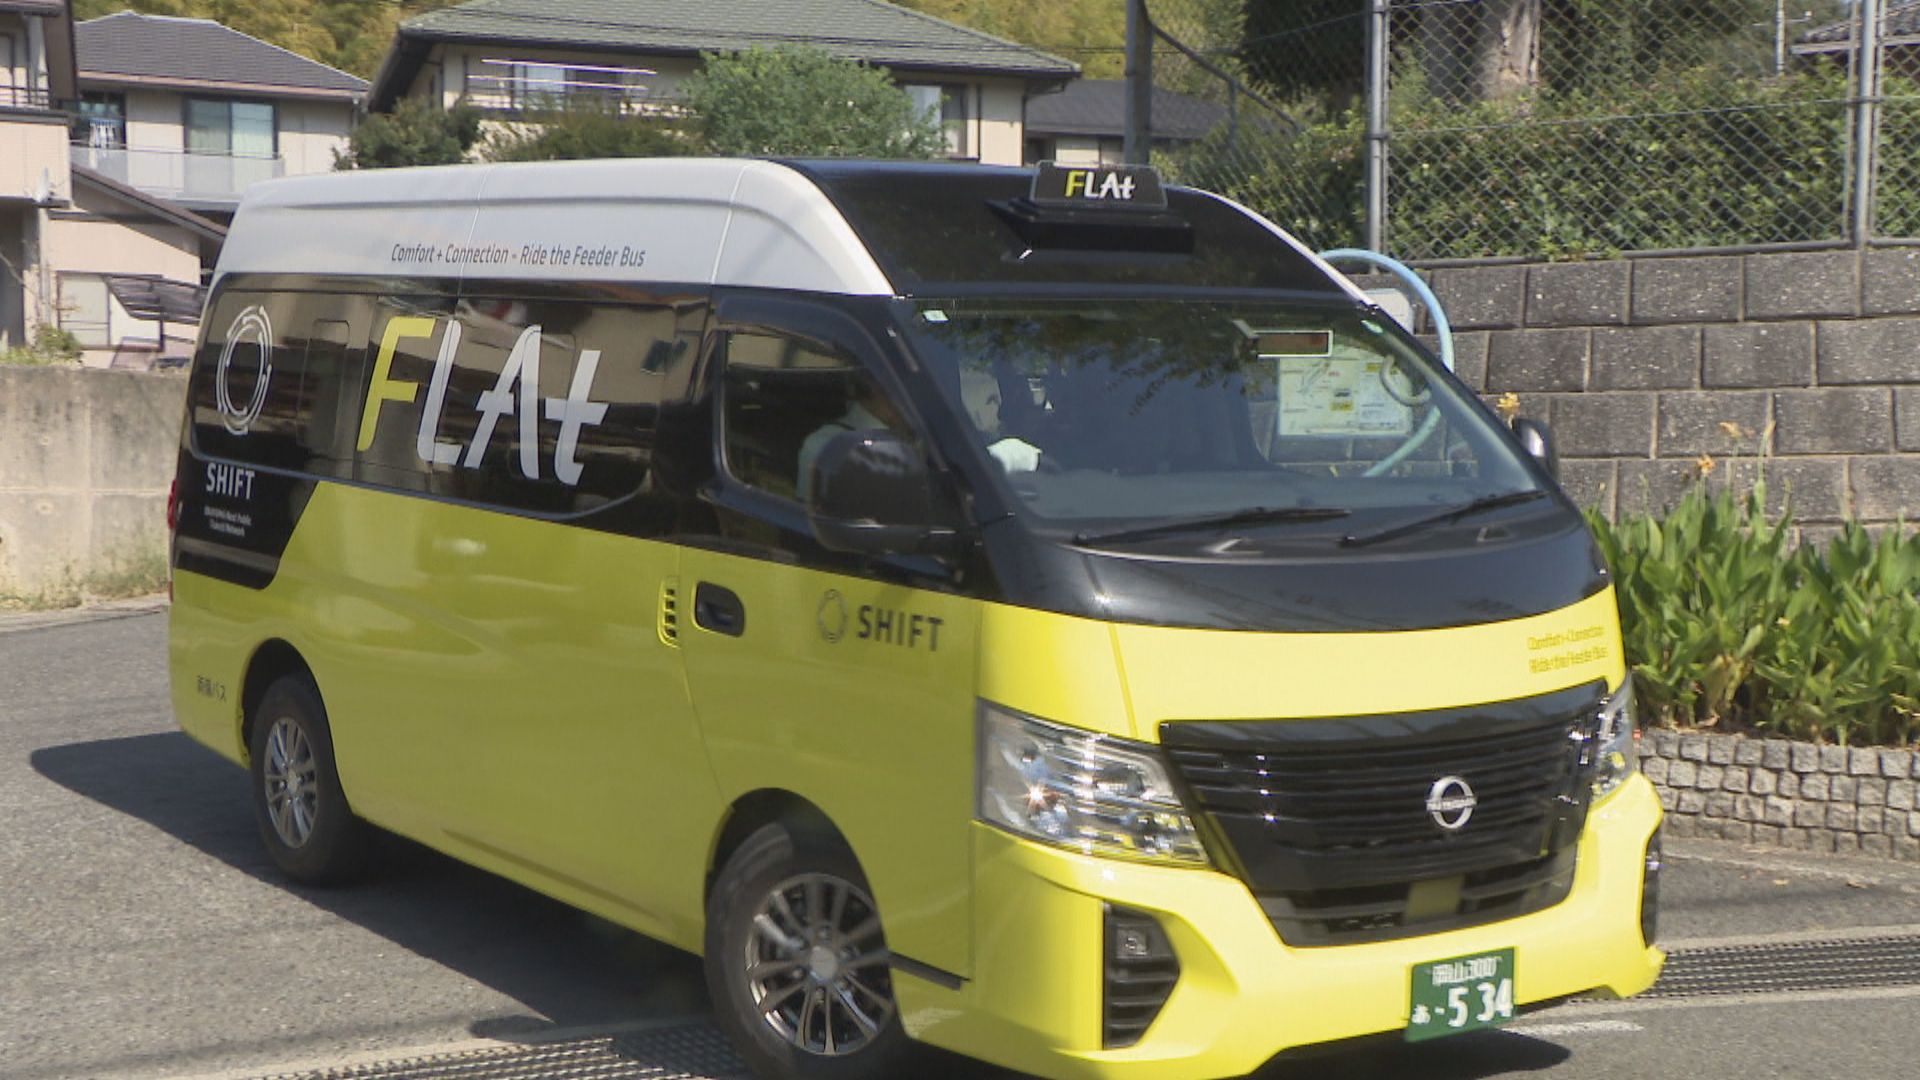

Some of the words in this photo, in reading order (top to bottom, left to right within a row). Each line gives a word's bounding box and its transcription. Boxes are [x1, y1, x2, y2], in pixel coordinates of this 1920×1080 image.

[391, 243, 435, 263] Comfort
[445, 243, 509, 264] Connection
[520, 244, 547, 265] Ride
[550, 244, 571, 266] the
[572, 244, 618, 267] Feeder
[620, 245, 646, 267] Bus
[206, 462, 256, 500] SHIFT
[857, 604, 944, 652] SHIFT
